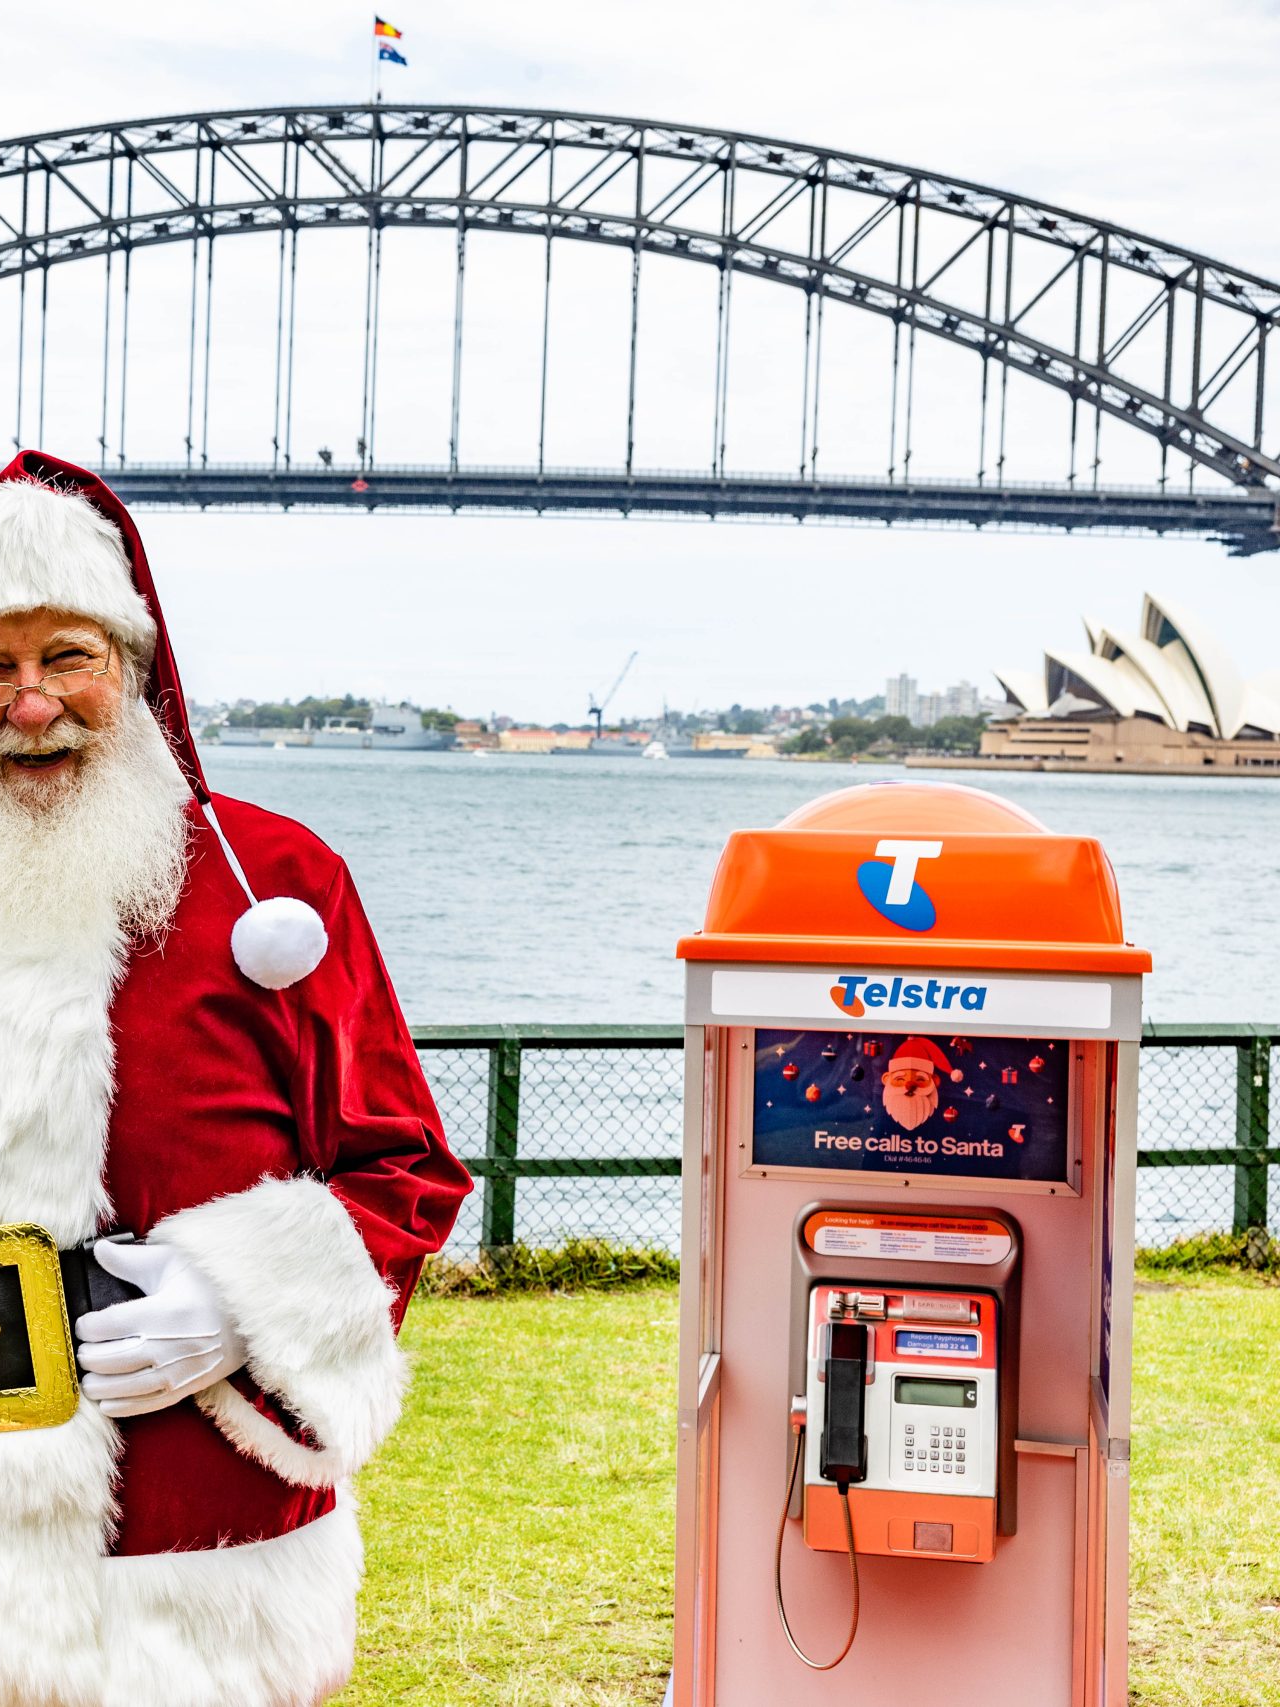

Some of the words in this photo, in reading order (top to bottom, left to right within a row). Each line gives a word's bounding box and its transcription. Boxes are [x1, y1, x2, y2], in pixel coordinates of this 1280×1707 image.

[874, 840, 943, 905] T
[837, 976, 988, 1012] Telstra
[814, 1130, 862, 1150] Free
[865, 1134, 912, 1154] calls
[916, 1136, 938, 1154] to
[941, 1136, 1004, 1158] Santa
[907, 1341, 934, 1349] Damage
